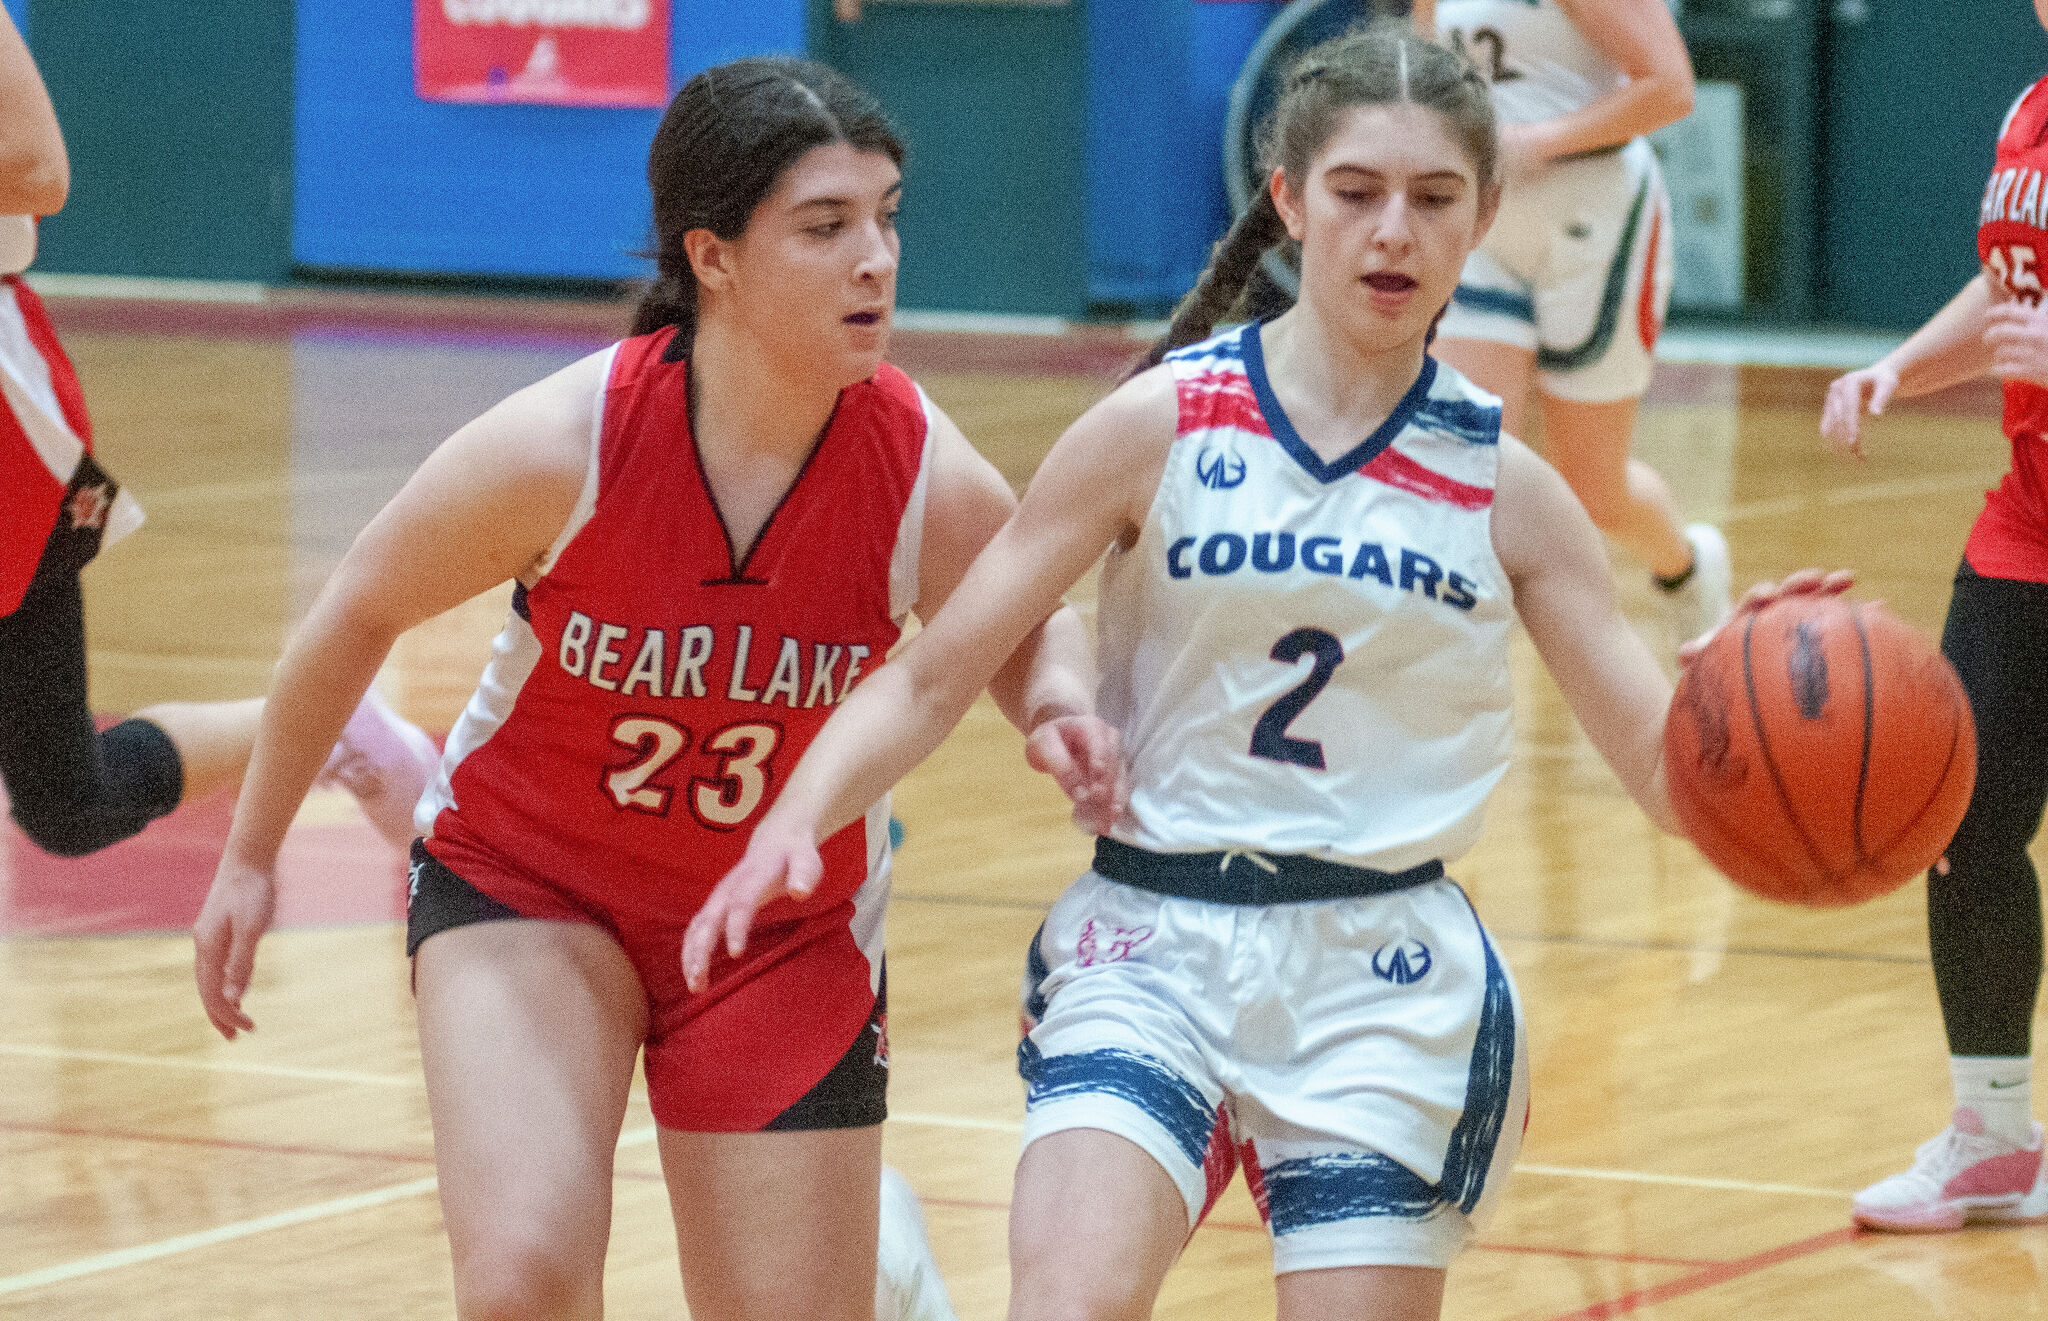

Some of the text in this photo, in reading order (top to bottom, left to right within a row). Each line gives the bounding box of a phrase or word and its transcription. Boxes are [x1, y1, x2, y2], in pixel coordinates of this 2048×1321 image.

[1166, 531, 1479, 612] COUGARS
[558, 609, 871, 709] BEAR LAKE
[1248, 625, 1346, 772] 2
[600, 712, 785, 833] 23
